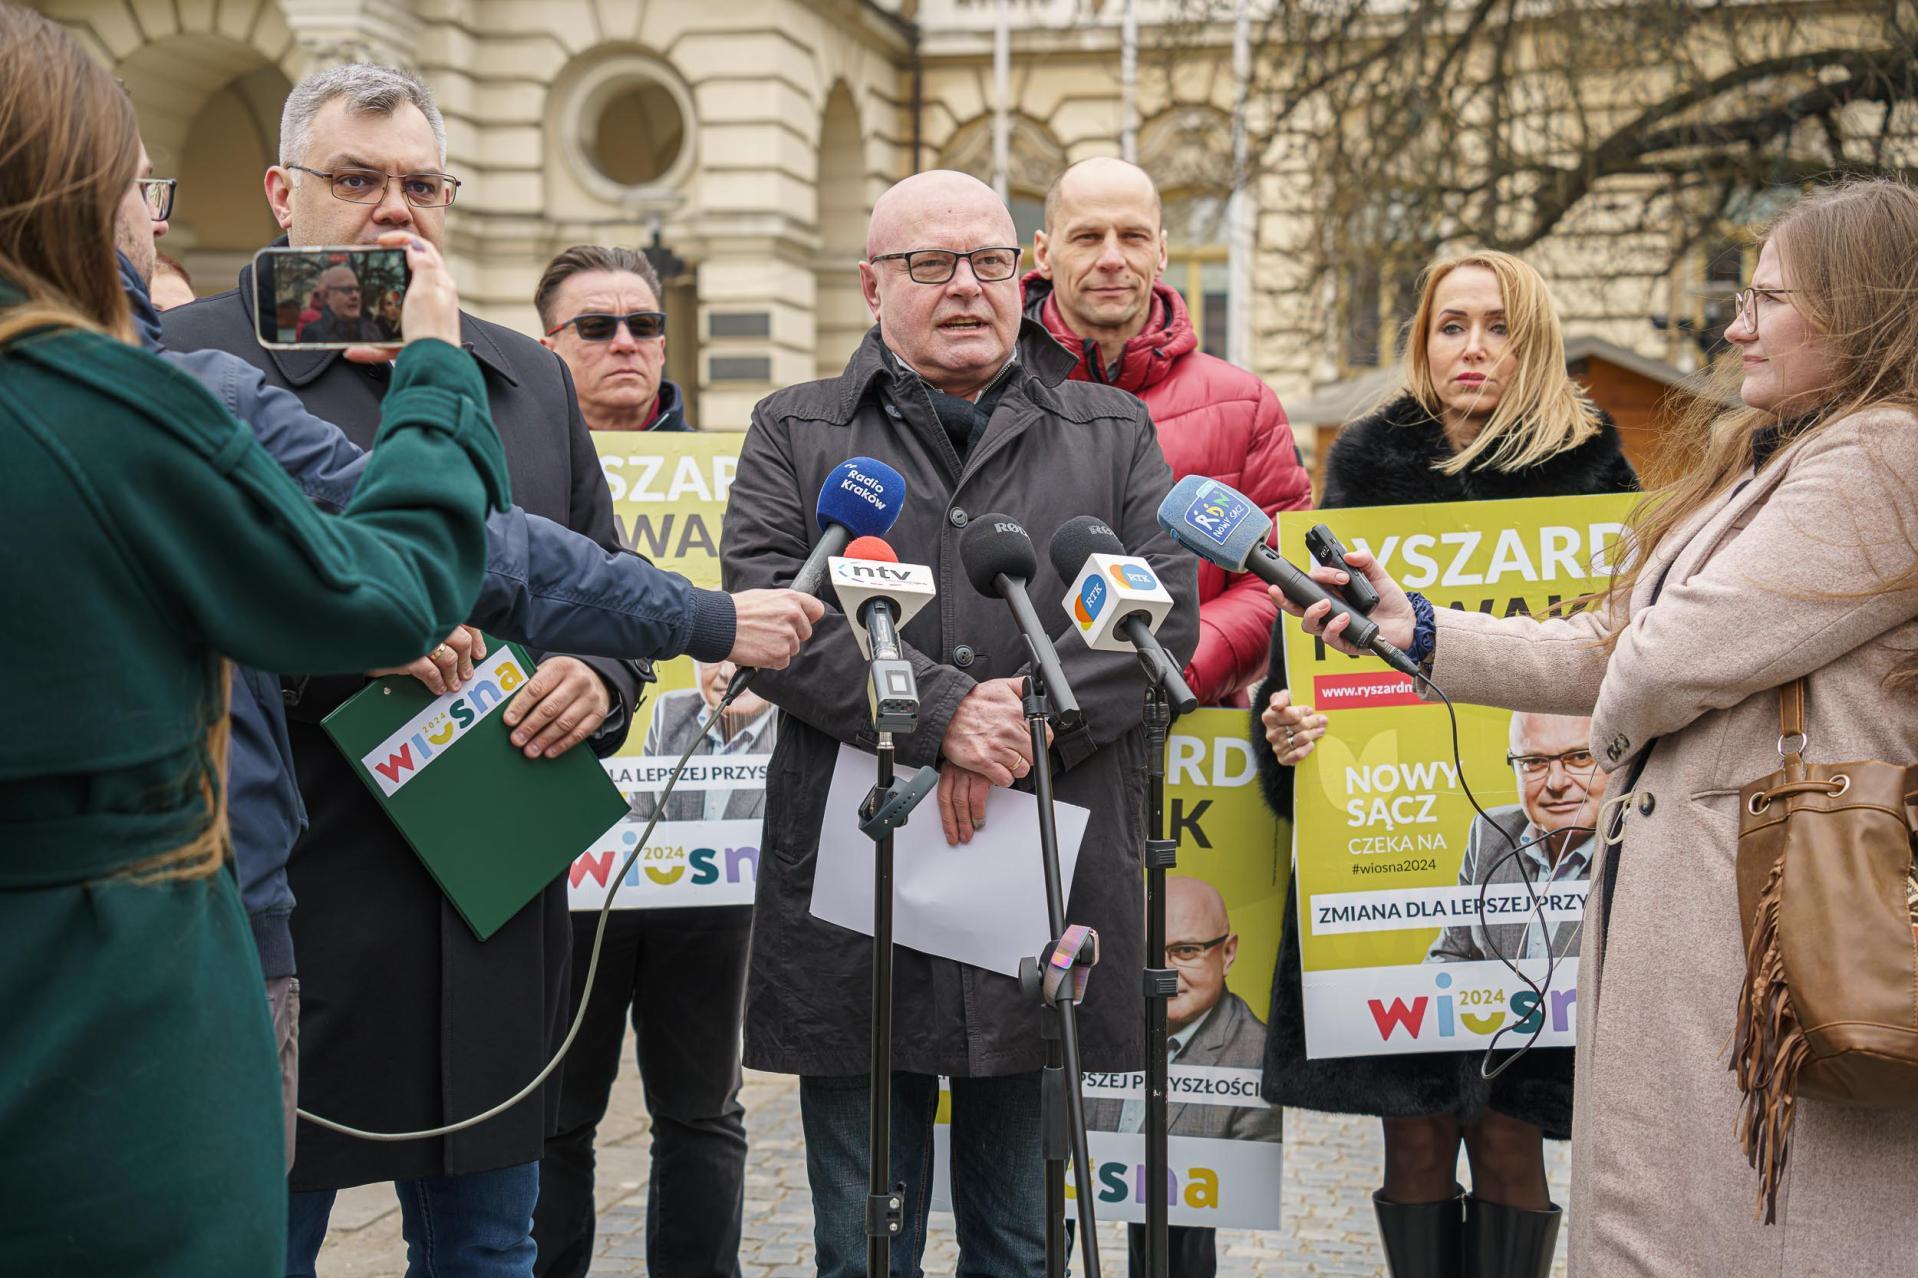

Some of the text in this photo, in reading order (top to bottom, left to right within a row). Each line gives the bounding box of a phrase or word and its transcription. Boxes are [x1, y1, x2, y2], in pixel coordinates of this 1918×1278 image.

[848, 469, 884, 493] Radio
[841, 479, 887, 511] Kraków
[1212, 517, 1233, 537] NOWY
[853, 565, 911, 581] ntv
[1128, 573, 1151, 584] RTK
[1086, 582, 1102, 609] RTK
[375, 661, 524, 784] wiosna
[422, 711, 446, 733] 2024
[636, 767, 706, 783] LEPSZEJ
[712, 765, 767, 781] PRZYS
[1345, 760, 1464, 794] NOWY
[1347, 794, 1438, 831] SĄCZ
[643, 846, 685, 860] 2024
[1348, 832, 1448, 855] CZEKA NA
[1352, 858, 1437, 875] #wiosna2024
[1319, 903, 1402, 923] ZMIANA
[1406, 900, 1447, 918] DLA
[1451, 895, 1531, 916] LEPSZEJ
[1459, 989, 1506, 1006] 2024
[1133, 1074, 1260, 1097] PYSZŁOŚCI
